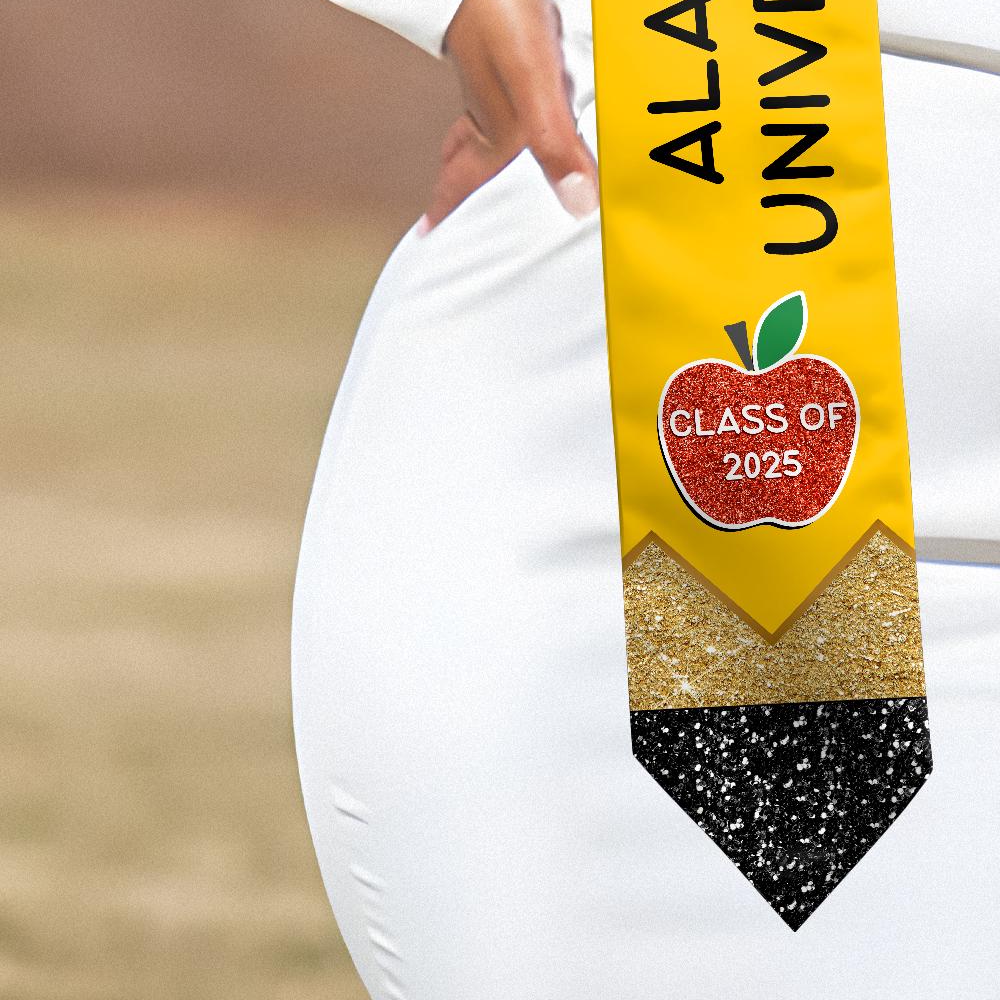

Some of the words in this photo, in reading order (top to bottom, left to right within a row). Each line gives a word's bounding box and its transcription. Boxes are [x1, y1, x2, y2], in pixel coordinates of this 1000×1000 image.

[669, 402, 789, 437] CLASS
[799, 402, 848, 431] OF
[722, 449, 804, 481] 2025
